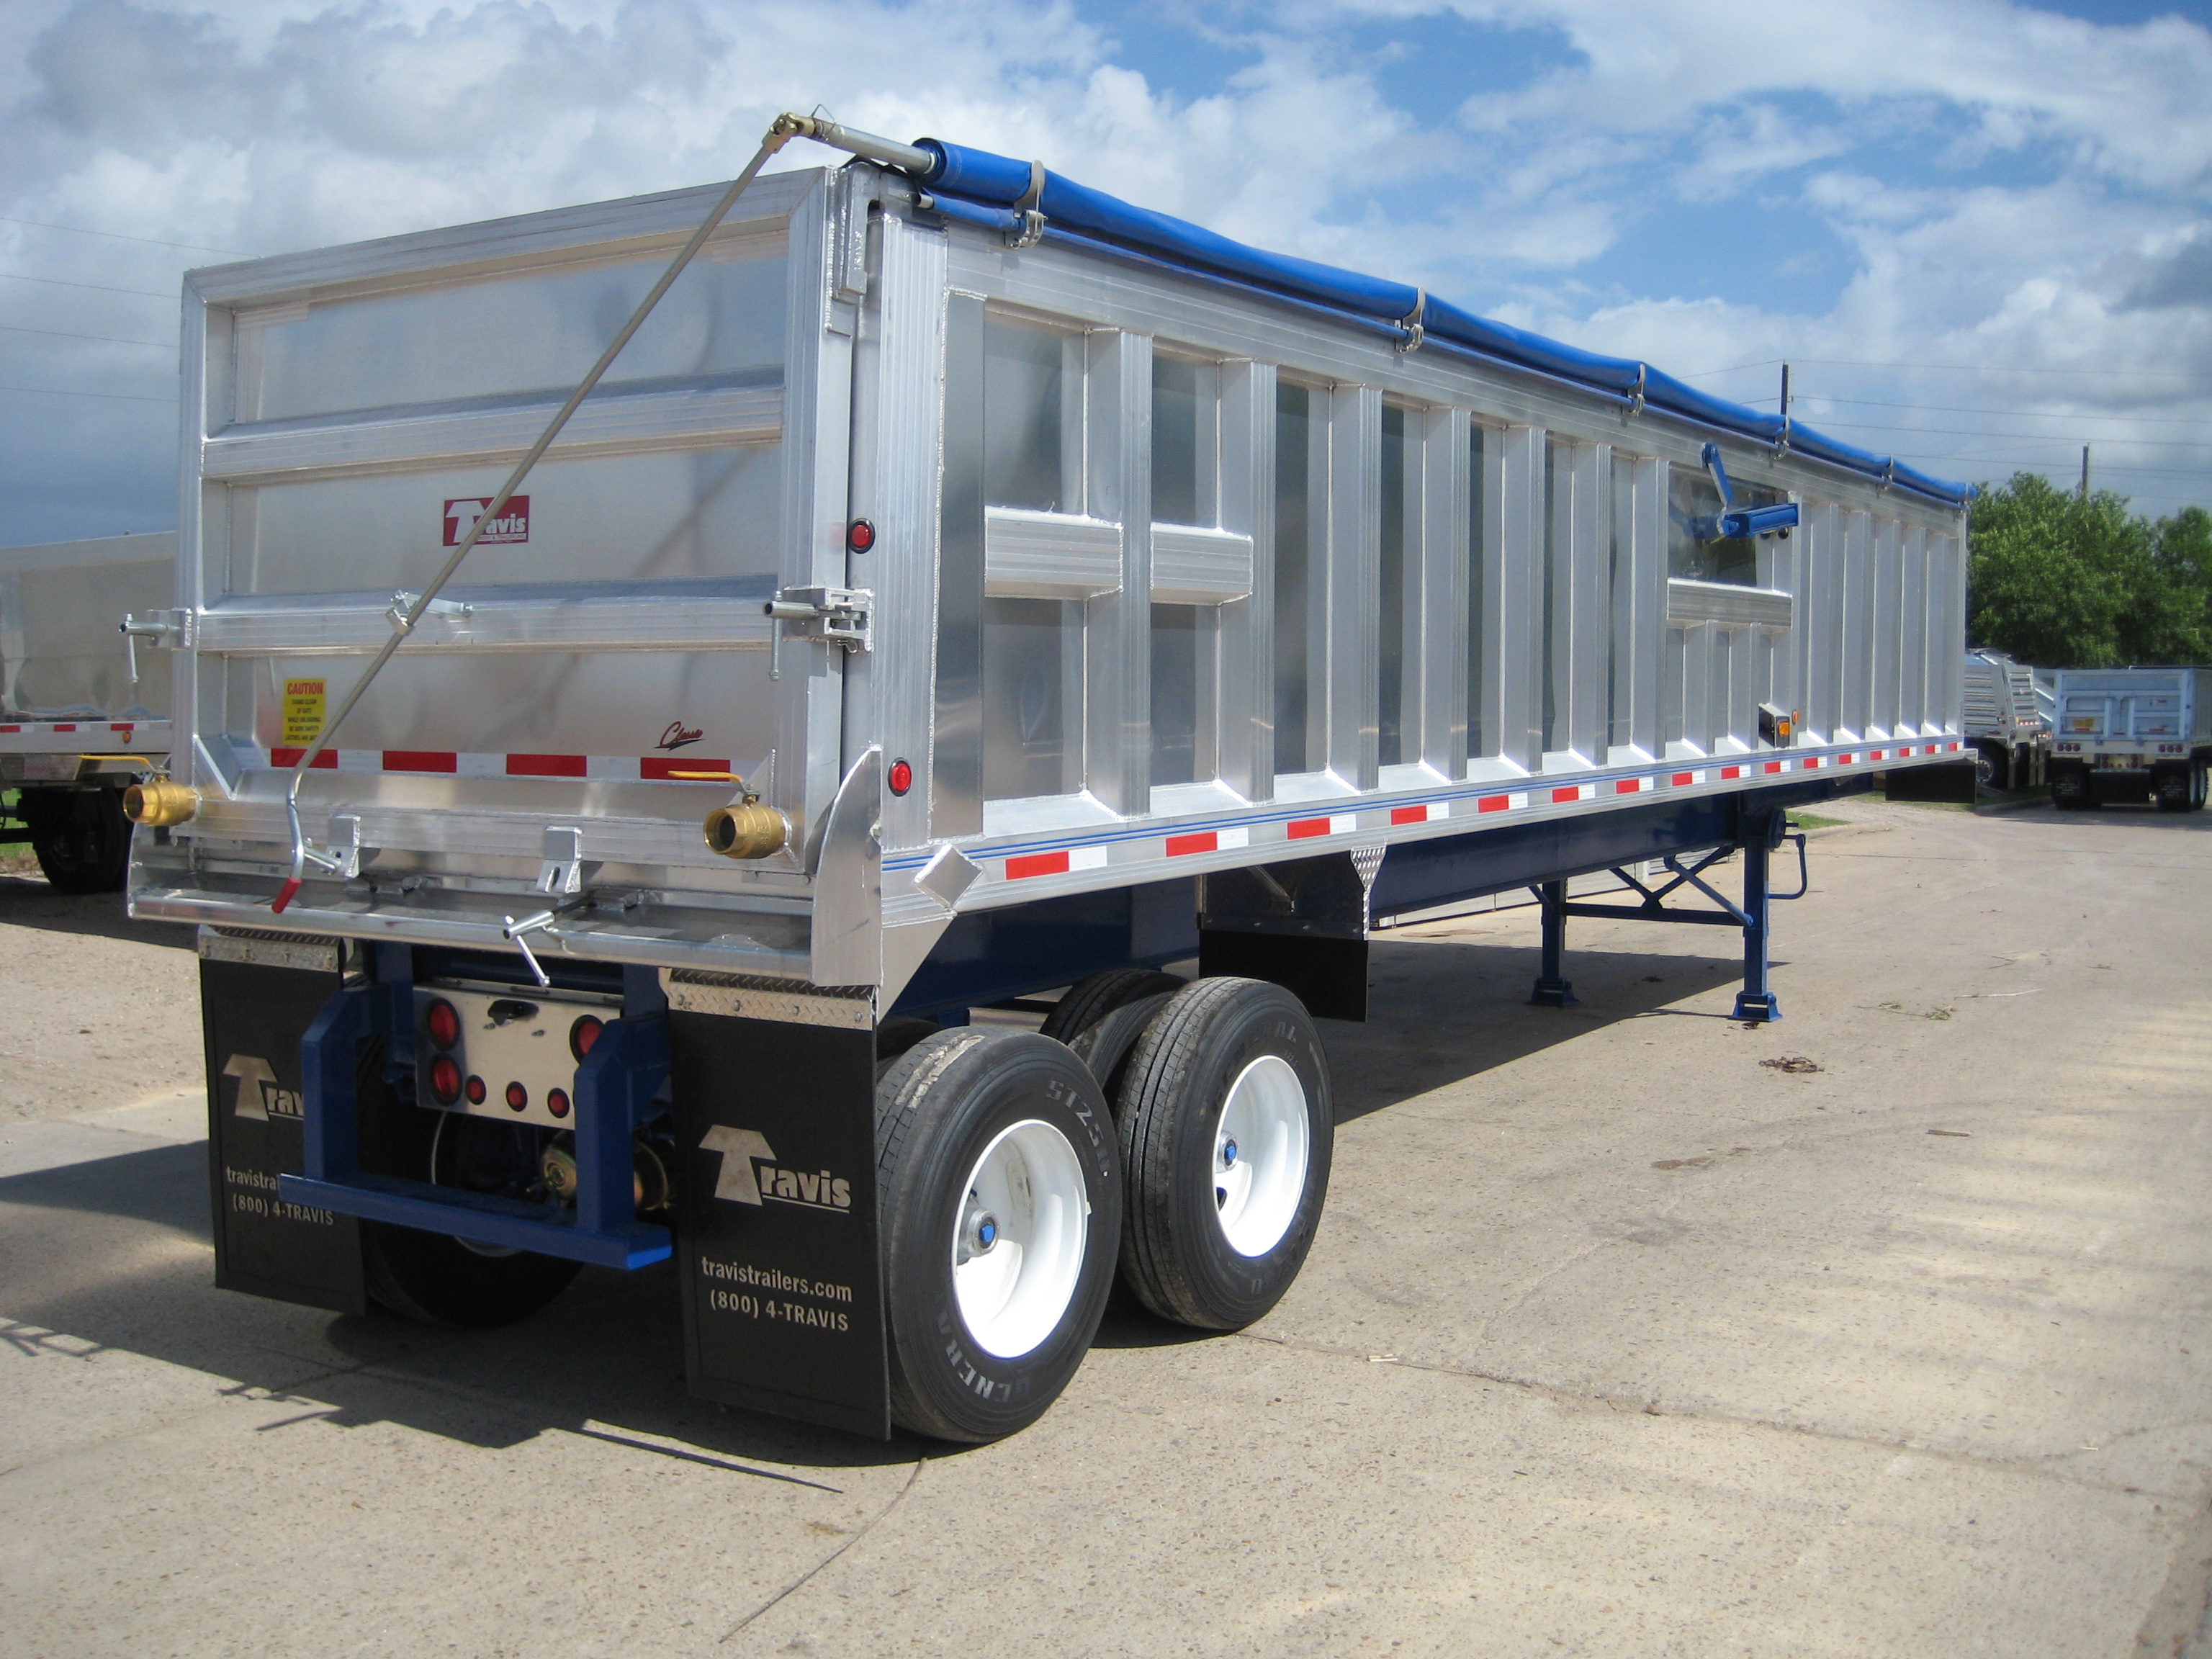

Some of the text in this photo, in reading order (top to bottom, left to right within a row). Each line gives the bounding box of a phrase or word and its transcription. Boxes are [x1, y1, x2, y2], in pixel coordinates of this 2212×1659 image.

[445, 500, 526, 543] Tavis
[288, 683, 323, 695] CAUTION
[222, 1053, 305, 1122] Trav
[698, 1124, 851, 1208] Travis
[233, 1193, 334, 1225] (800) 4-TRAVIS
[701, 1256, 853, 1302] travistrailers.com
[710, 1289, 848, 1331] (800) 4-TRAVIS
